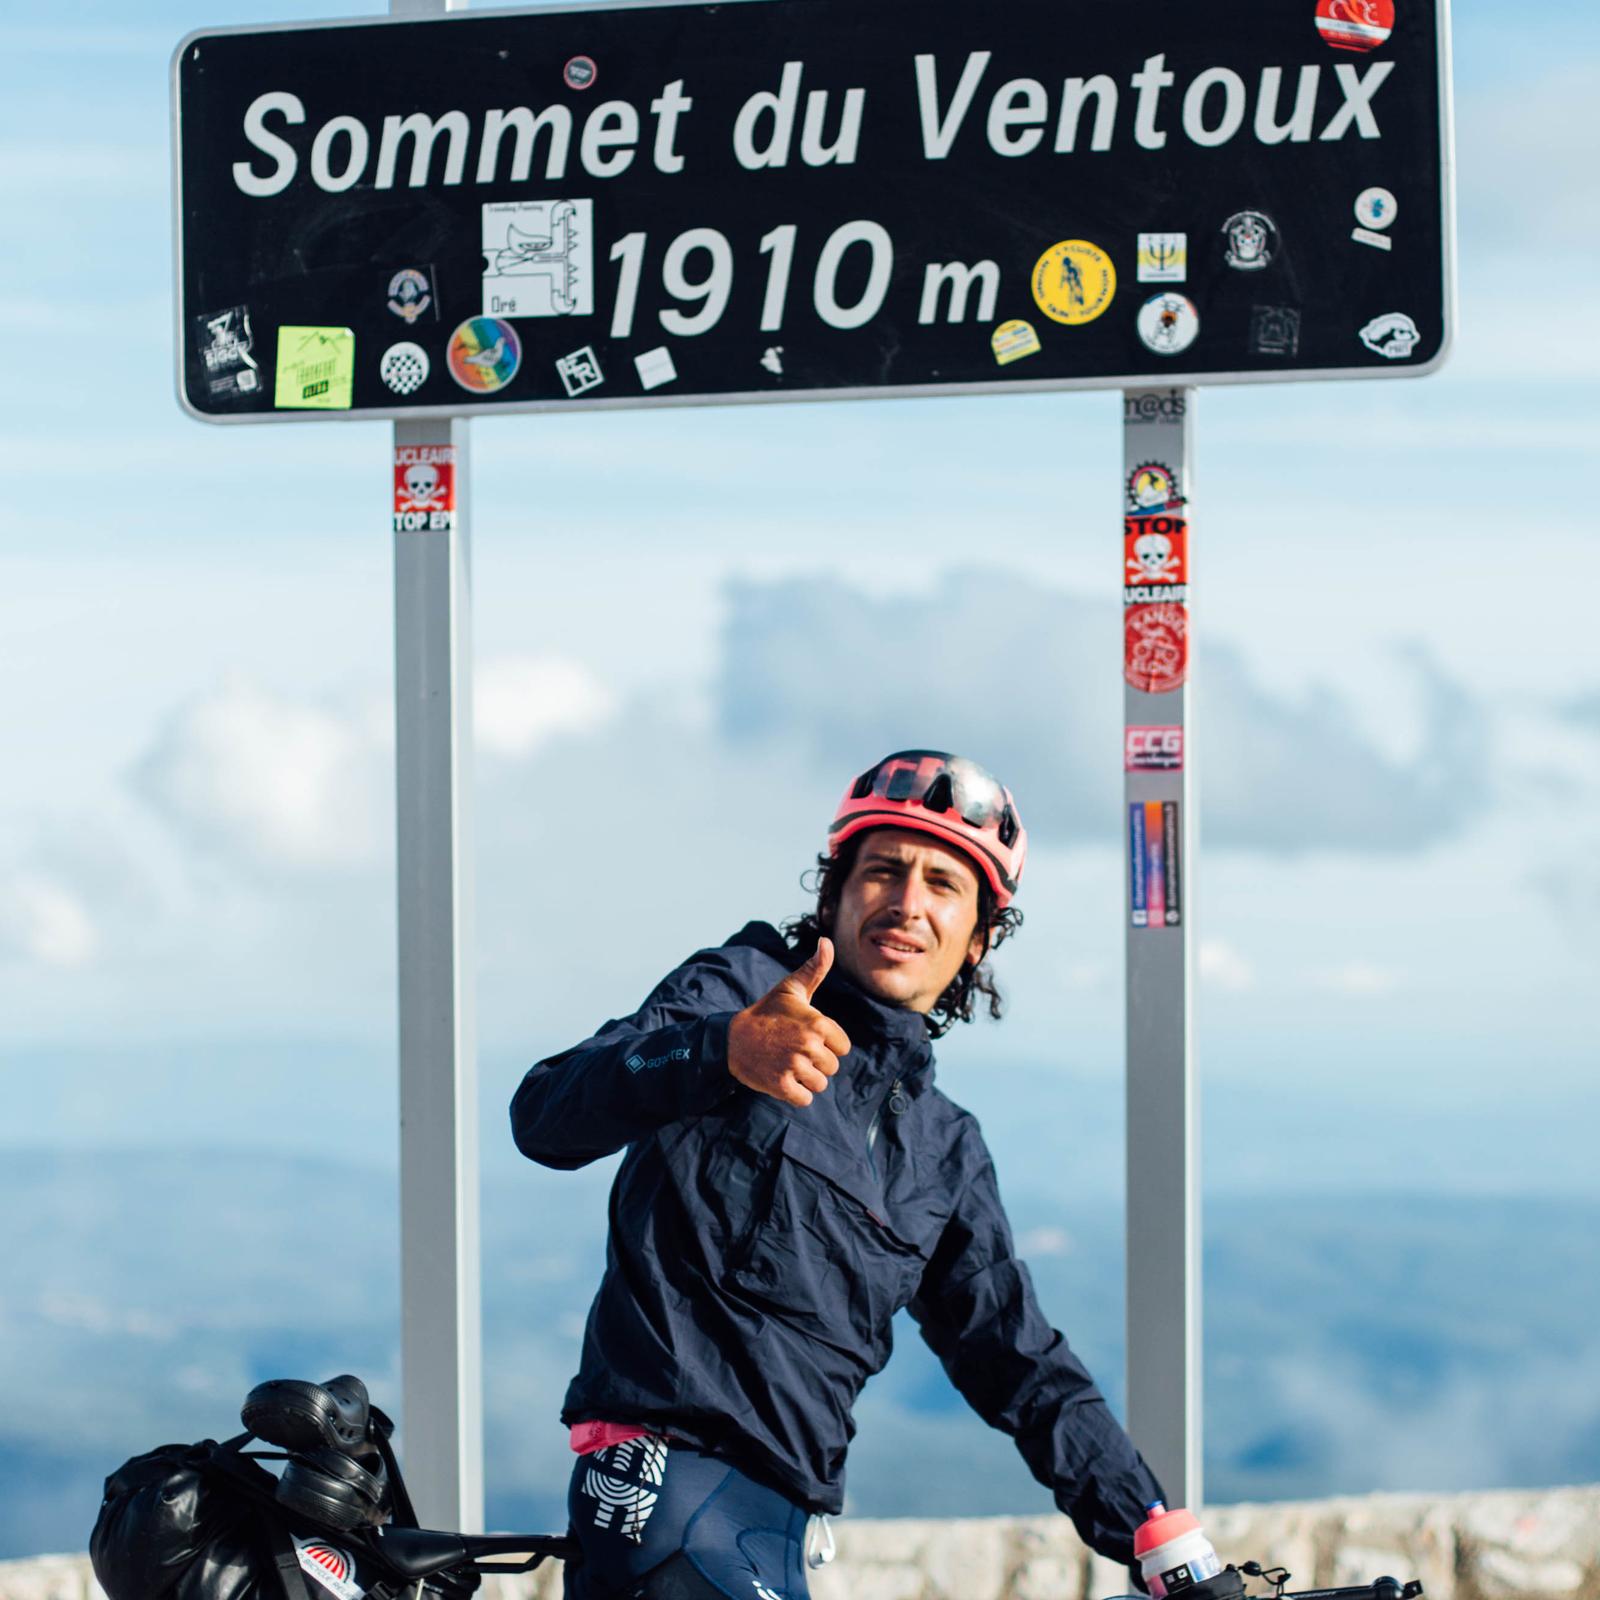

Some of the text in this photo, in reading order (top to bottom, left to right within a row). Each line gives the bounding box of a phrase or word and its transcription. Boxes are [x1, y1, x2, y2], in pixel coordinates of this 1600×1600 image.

[232, 51, 1395, 197] Sommet du Ventoux
[609, 220, 893, 338] 1910
[918, 260, 1000, 324] m
[1124, 516, 1187, 535] STOP
